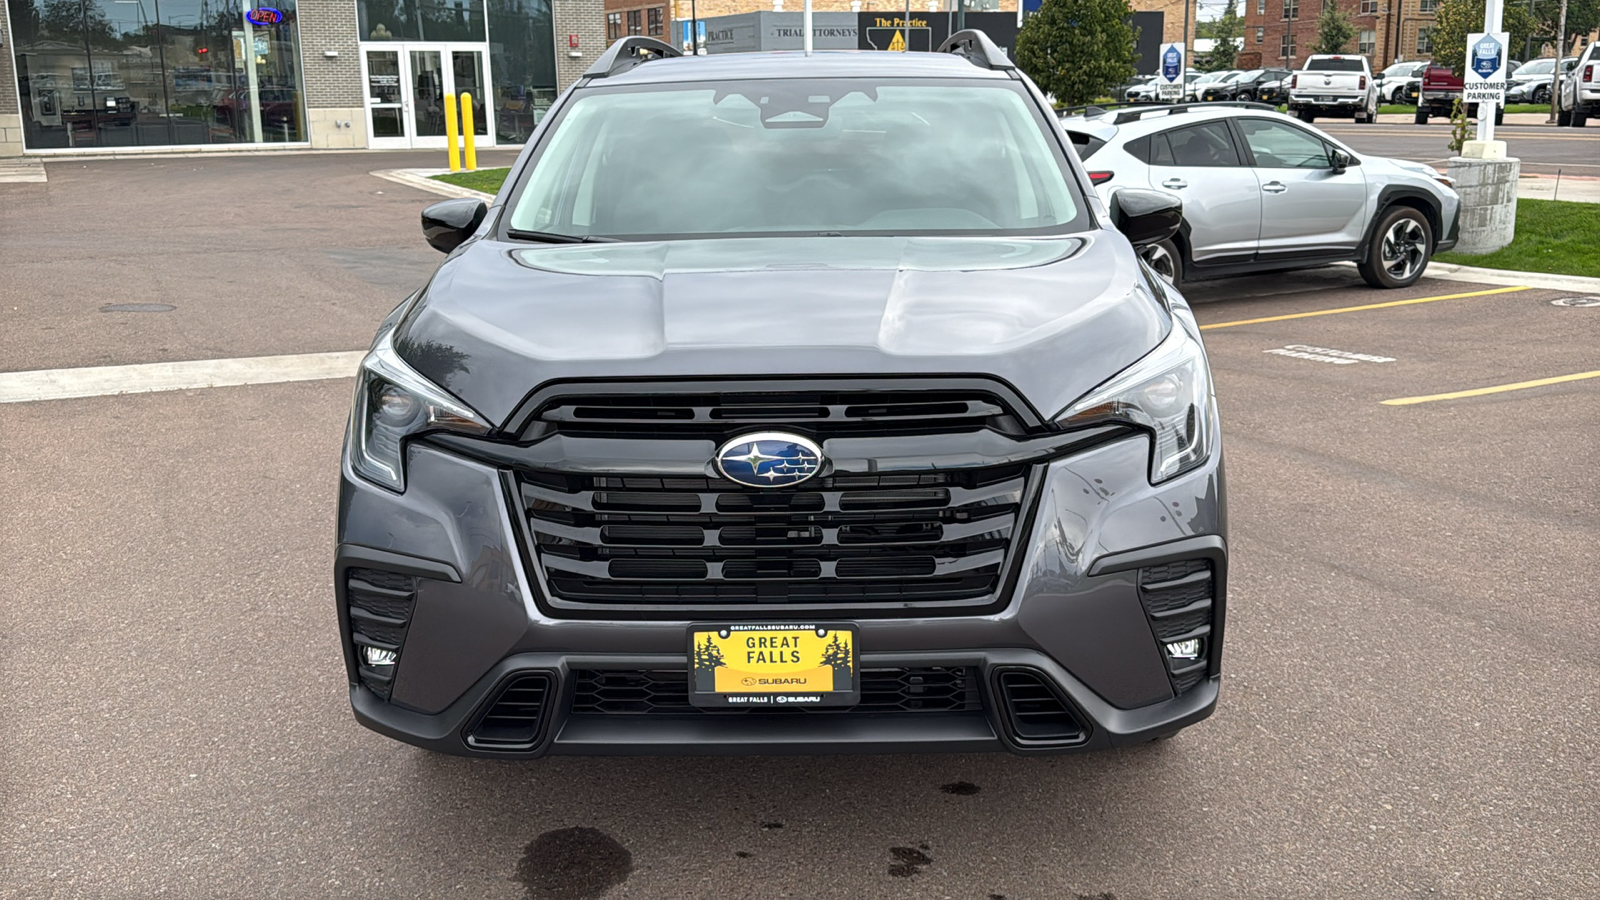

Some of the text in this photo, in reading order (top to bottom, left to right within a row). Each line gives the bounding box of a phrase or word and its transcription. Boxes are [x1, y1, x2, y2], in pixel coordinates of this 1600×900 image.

[250, 9, 277, 24] OPEN
[874, 17, 892, 27] The
[707, 30, 734, 42] PRACTICE
[776, 28, 858, 37] TRIAL TTORNEYS
[1464, 82, 1506, 90] CUSTOMER
[1466, 92, 1501, 100] PARKING
[746, 636, 801, 649] GREAT
[746, 650, 801, 664] FALLS
